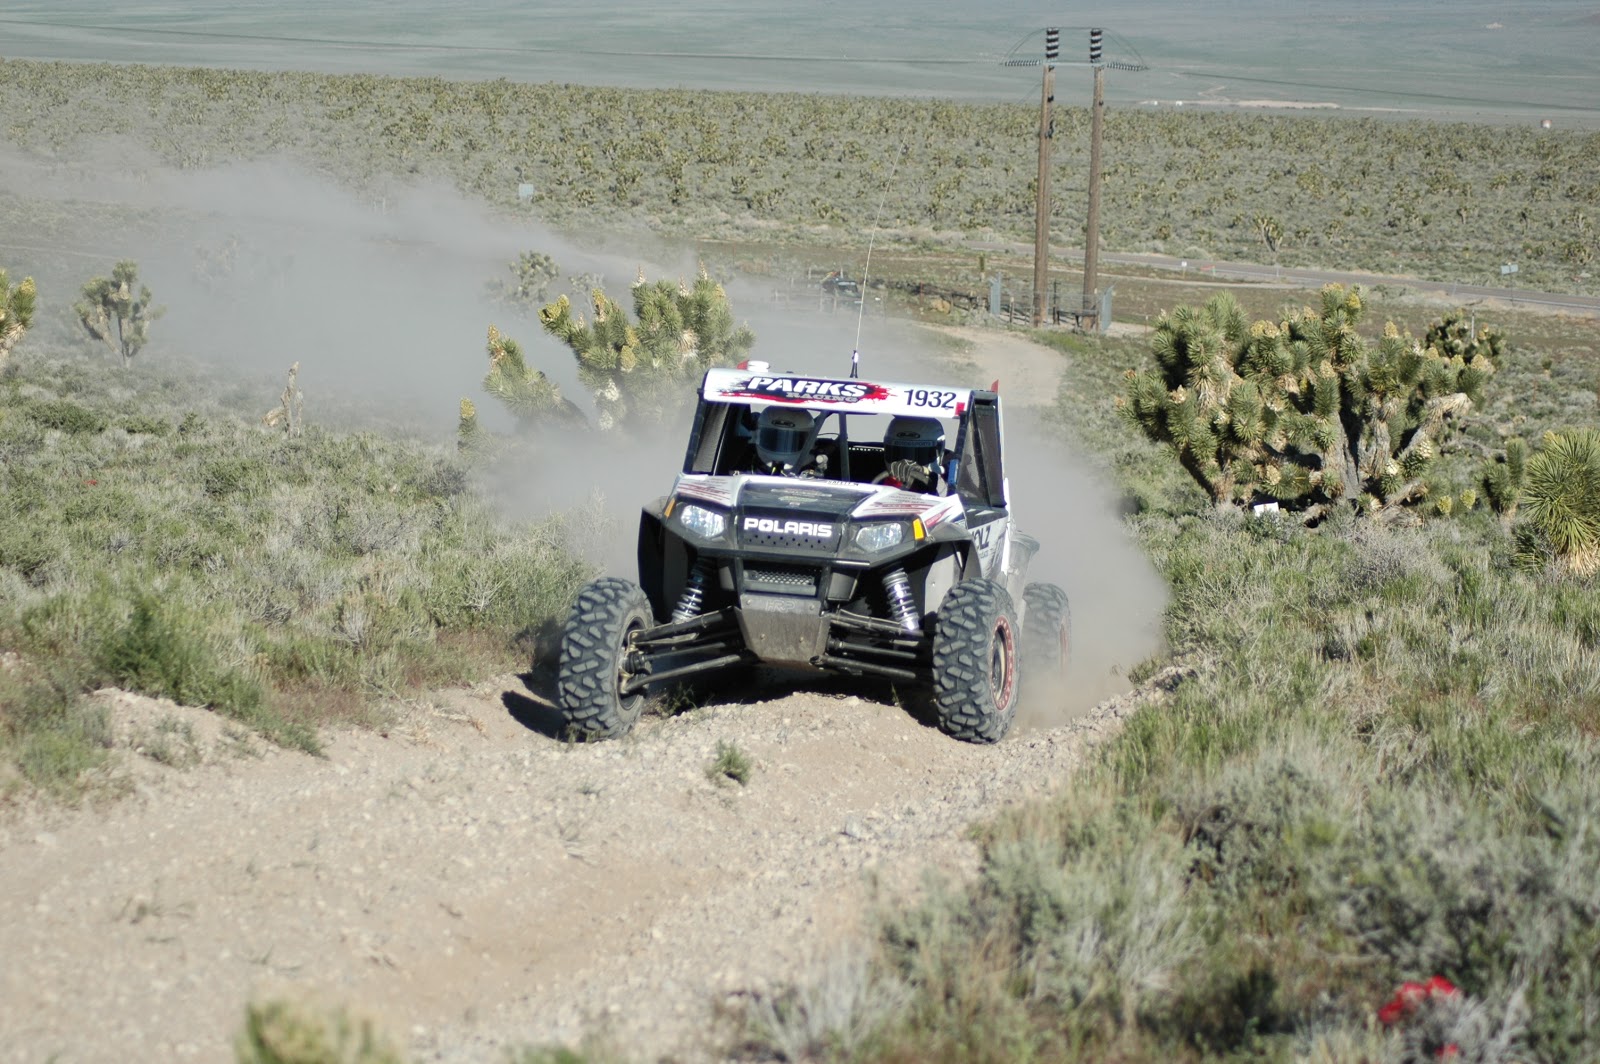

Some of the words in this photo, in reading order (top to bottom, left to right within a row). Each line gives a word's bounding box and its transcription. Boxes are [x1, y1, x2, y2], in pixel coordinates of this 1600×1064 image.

[747, 376, 868, 397] PARKS
[786, 391, 860, 403] RACING
[903, 388, 957, 409] 1932
[743, 517, 833, 538] POLARIS
[971, 524, 992, 550] OLZ
